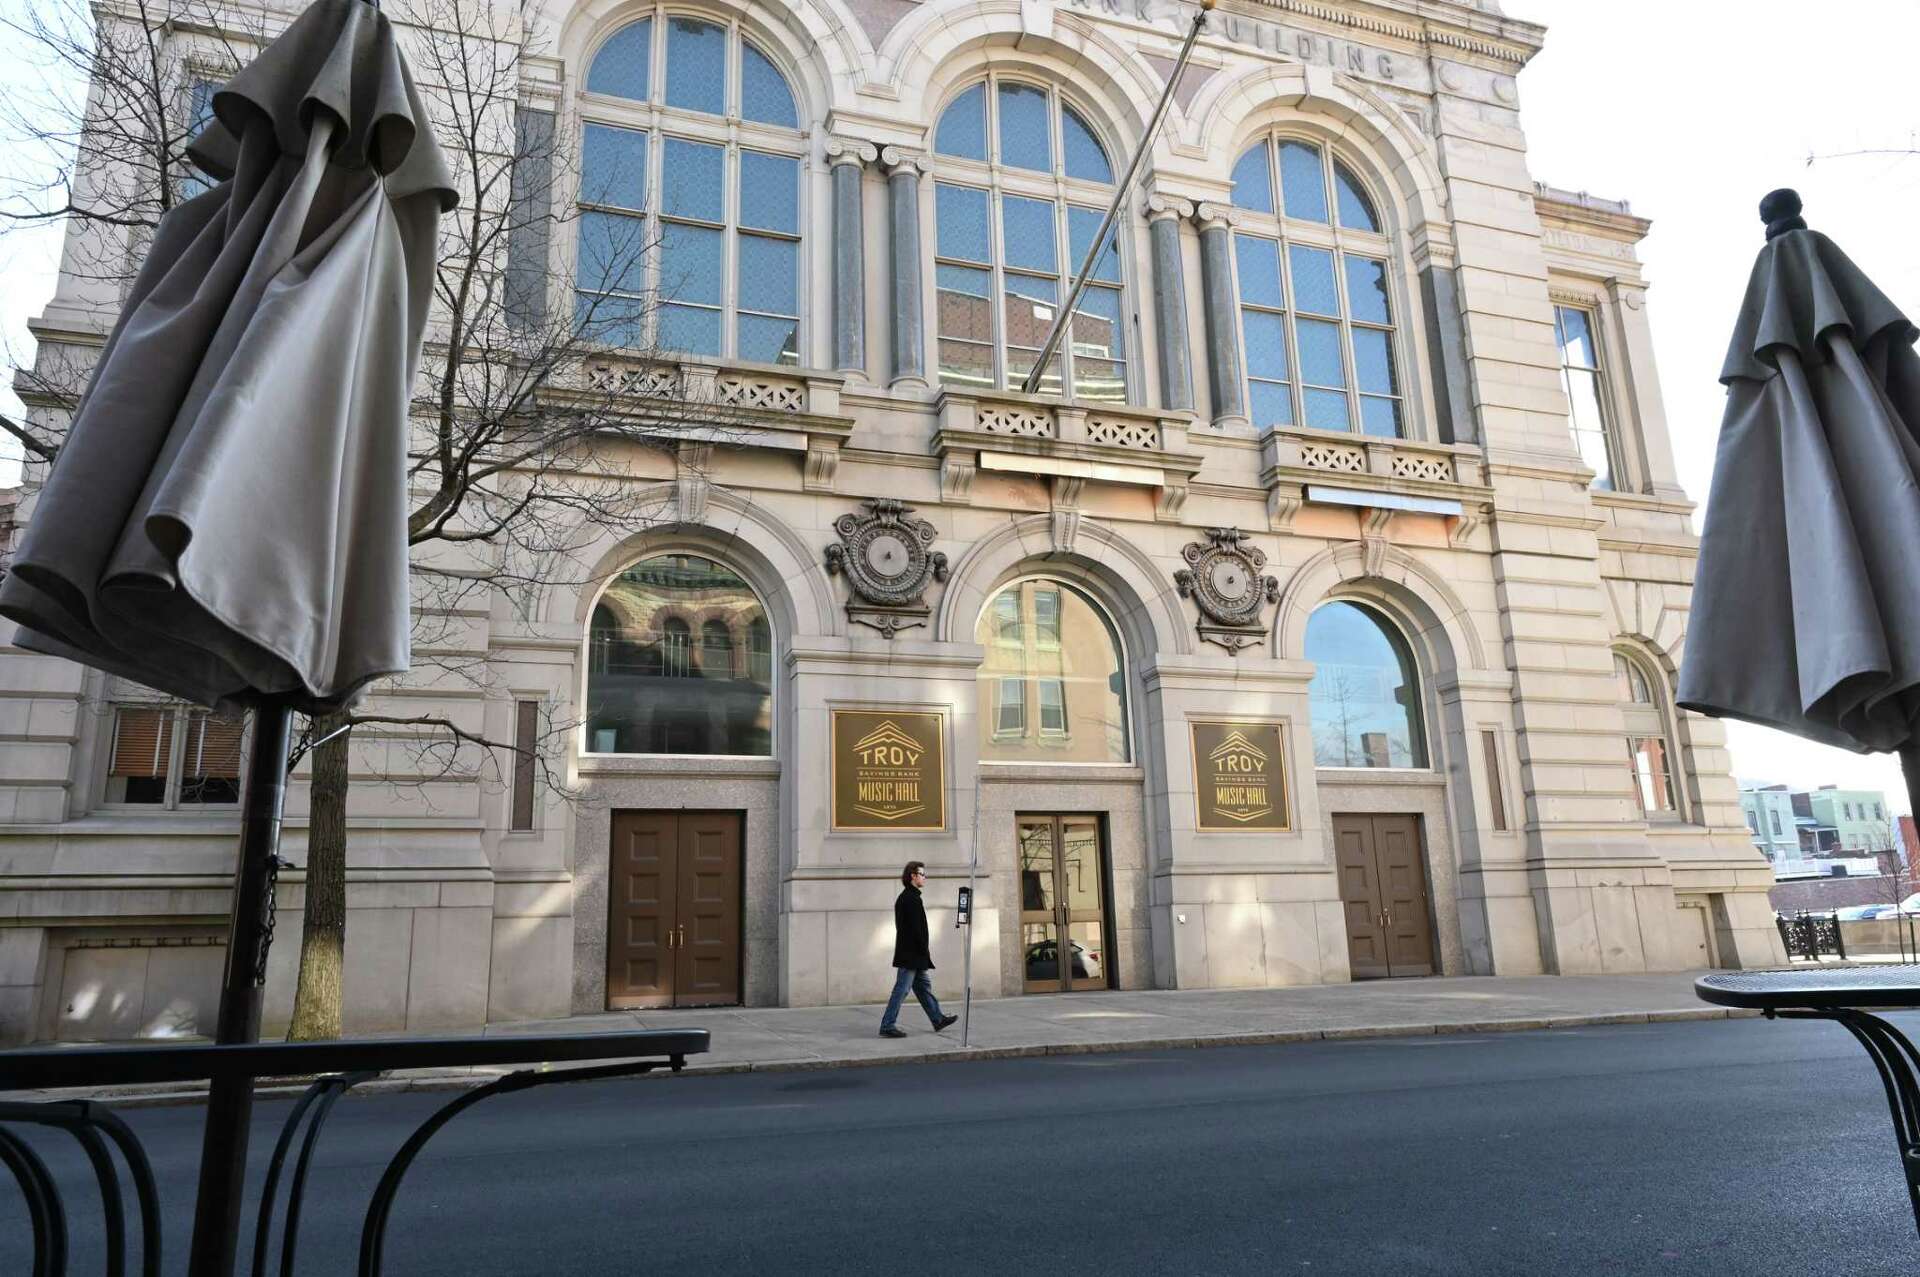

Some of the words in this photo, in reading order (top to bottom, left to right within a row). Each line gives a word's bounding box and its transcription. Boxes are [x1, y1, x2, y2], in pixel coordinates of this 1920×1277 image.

[1199, 12, 1394, 79] UILDING
[860, 746, 919, 765] TROY
[1215, 755, 1264, 772] TROY
[859, 782, 893, 801] MUSIC
[895, 782, 920, 802] HALL
[1216, 787, 1245, 805] MUSIC
[1247, 787, 1267, 805] HALL
